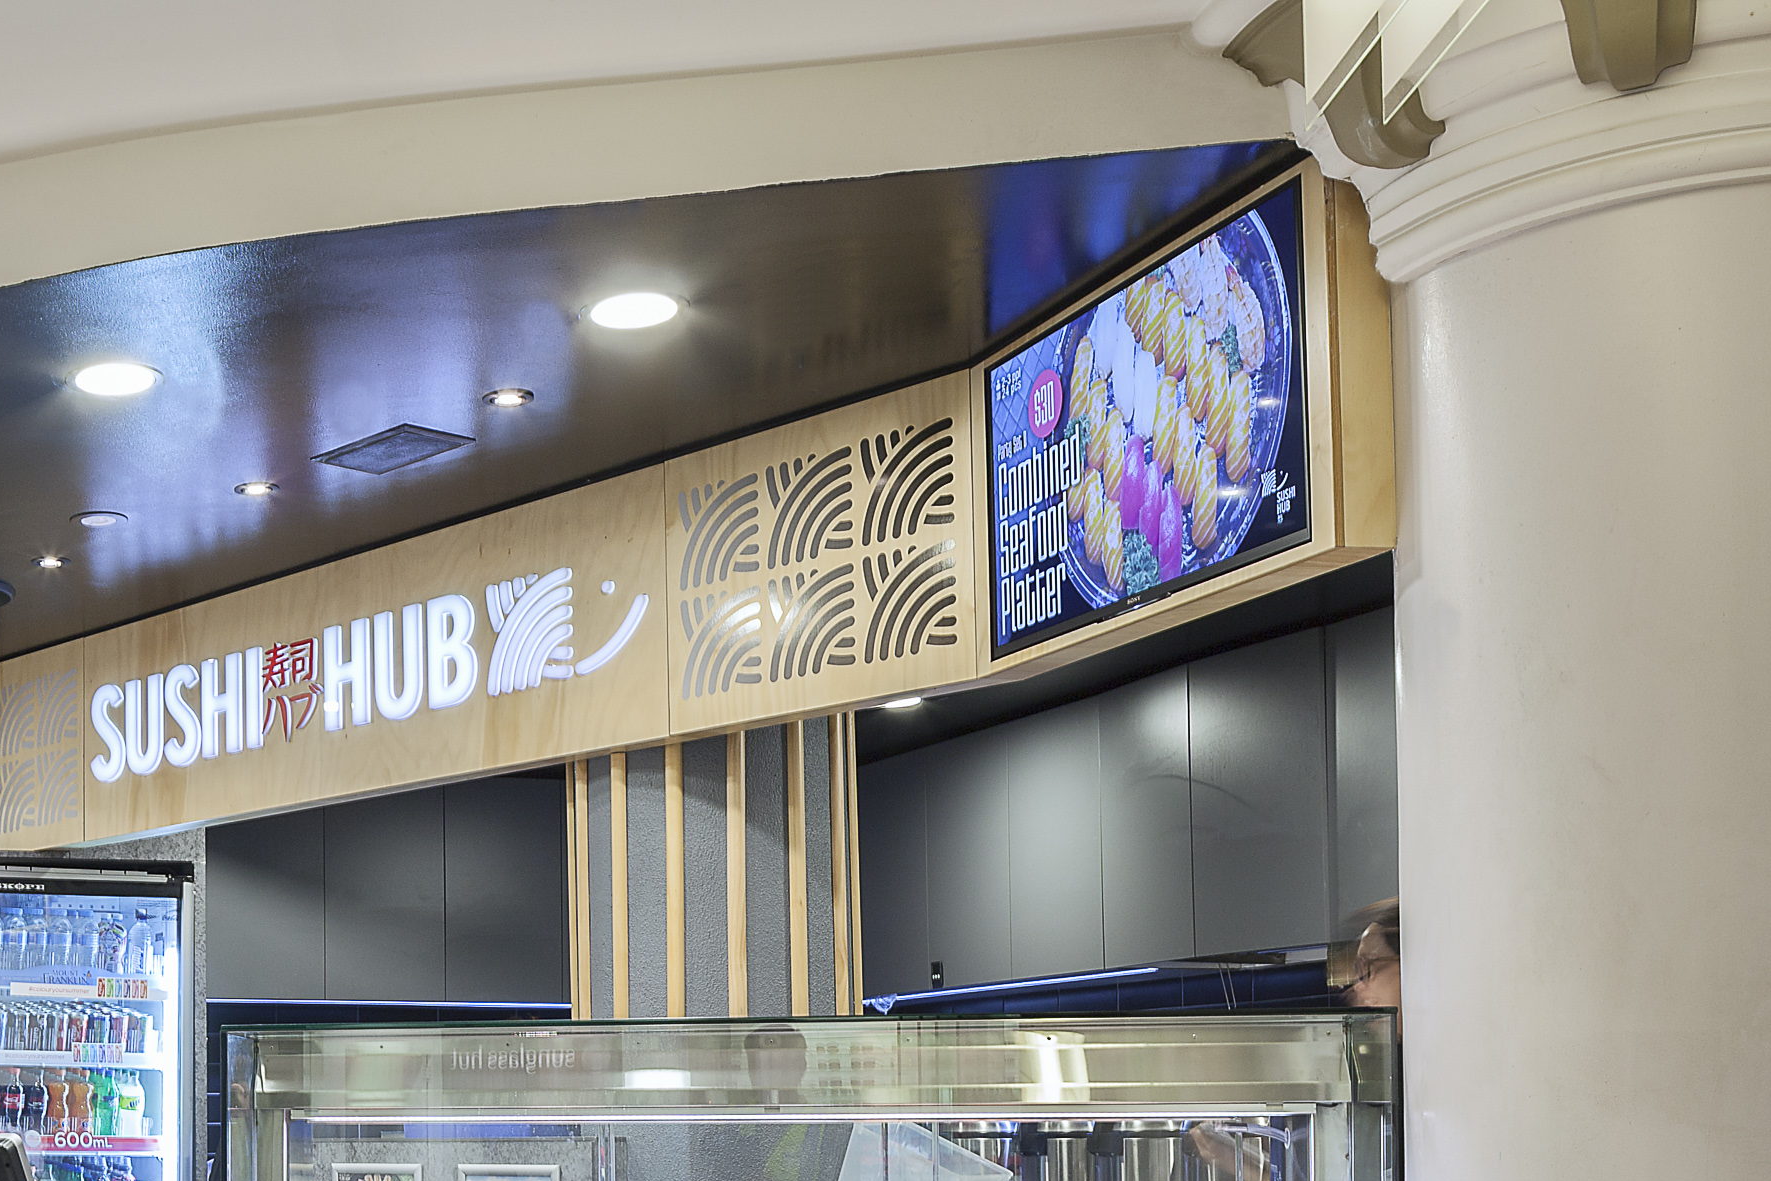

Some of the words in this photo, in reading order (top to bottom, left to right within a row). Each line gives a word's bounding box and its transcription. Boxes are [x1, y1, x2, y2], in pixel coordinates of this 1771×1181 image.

[1001, 372, 1011, 385] 2-3
[1001, 384, 1010, 399] 24
[1010, 379, 1022, 396] pcs
[1033, 380, 1055, 428] $30
[997, 440, 1013, 462] Party
[998, 424, 1081, 521] Combined
[1276, 485, 1296, 502] SUSHI
[1276, 501, 1291, 515] HUB
[1000, 490, 1069, 578] Seafood
[1000, 562, 1067, 636] Platter
[1126, 595, 1141, 605] SONY
[261, 636, 319, 690] 寿司
[89, 643, 264, 783] SUSHI
[323, 592, 479, 732] HUB
[261, 681, 324, 742] ハブ
[43, 973, 90, 985] FRANKLIN
[28, 986, 90, 994] #colouryoursummer
[54, 1131, 113, 1149] 600mL
